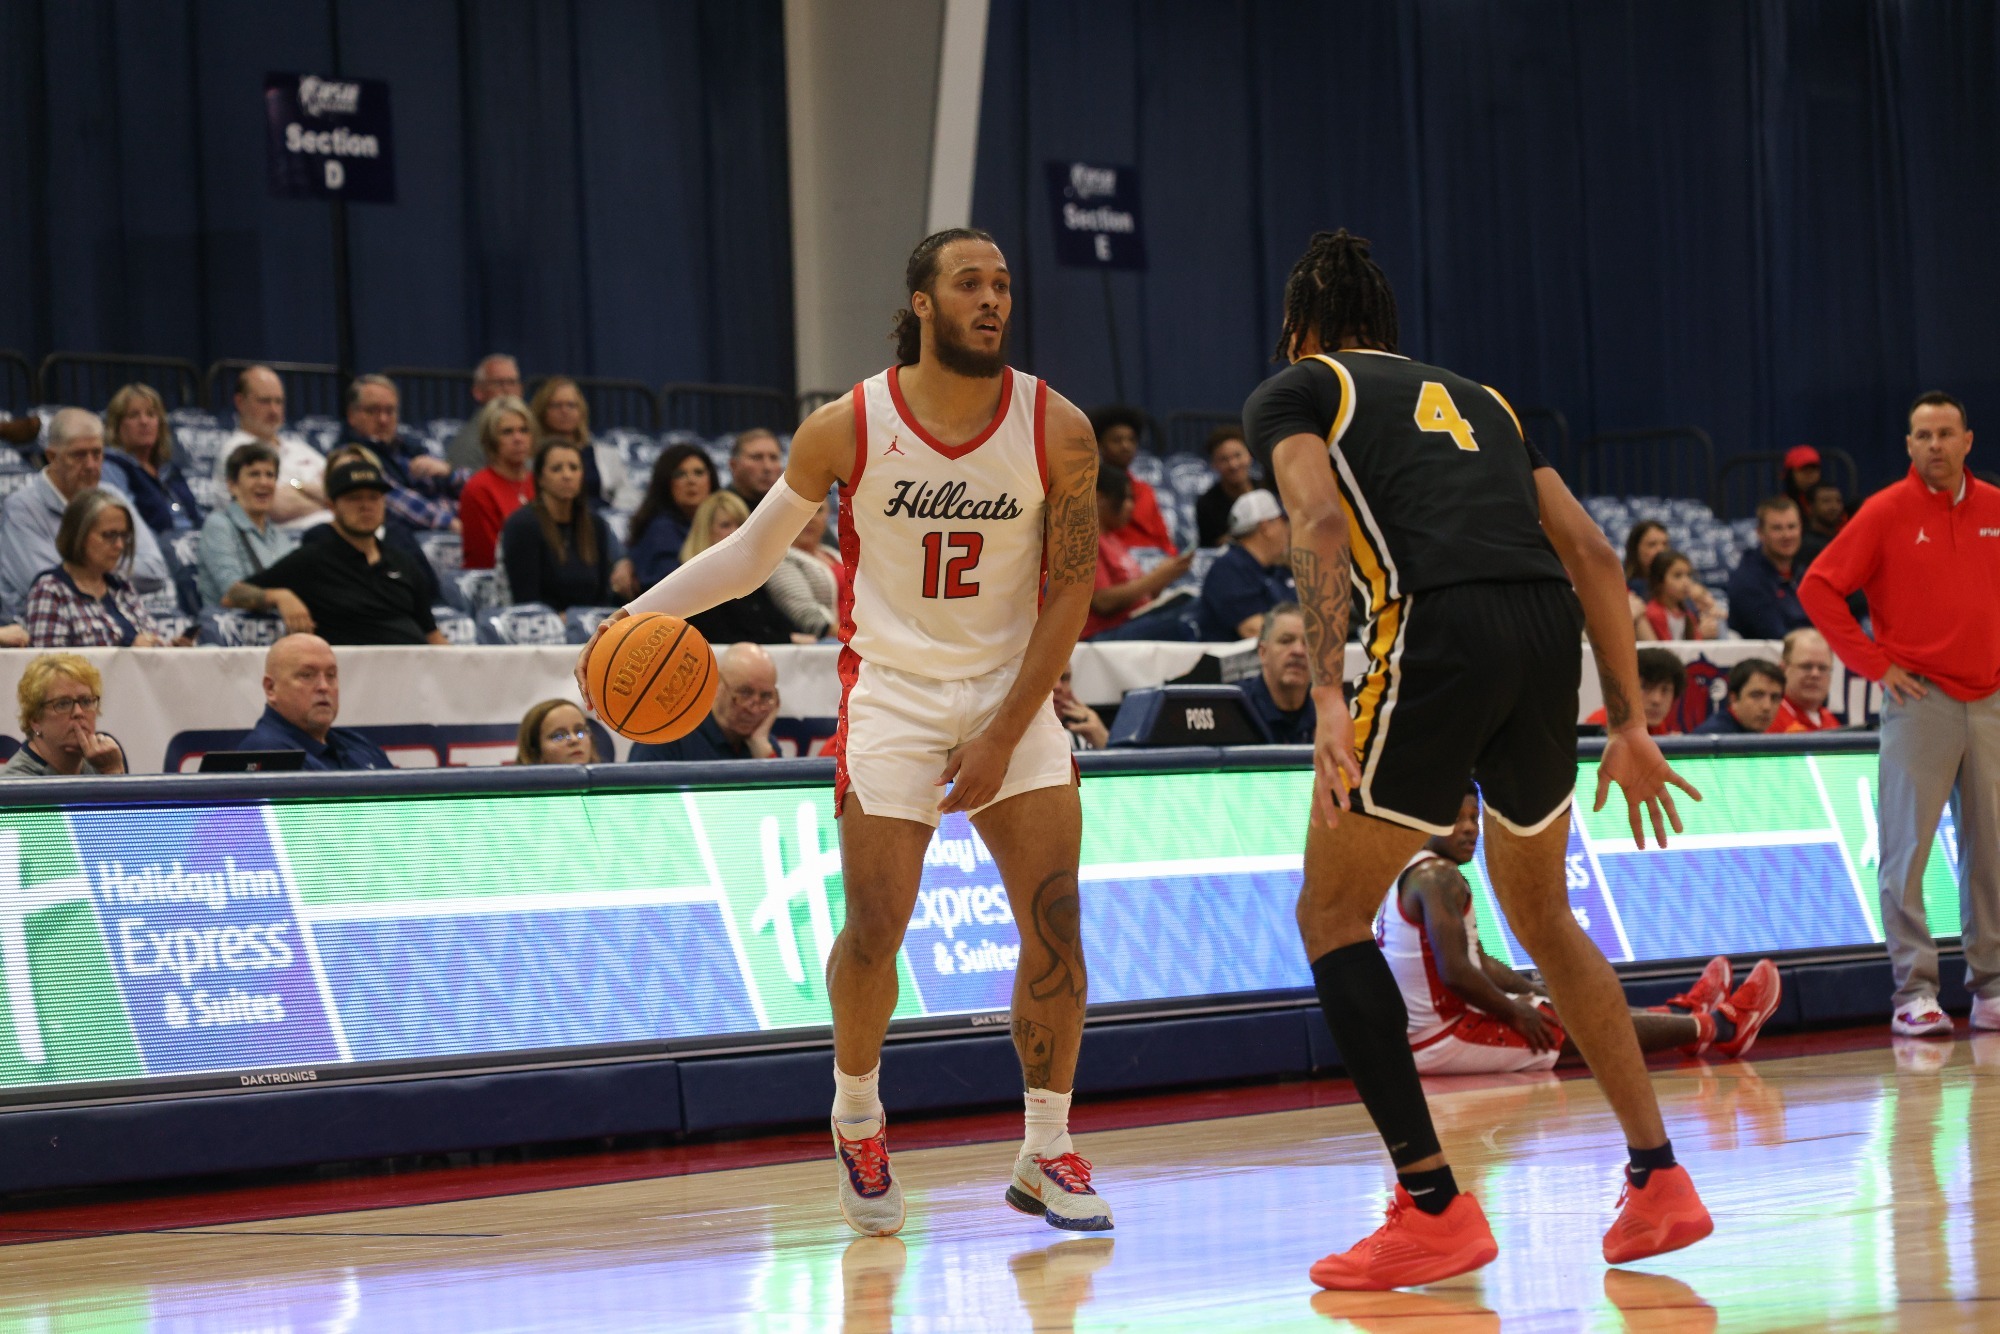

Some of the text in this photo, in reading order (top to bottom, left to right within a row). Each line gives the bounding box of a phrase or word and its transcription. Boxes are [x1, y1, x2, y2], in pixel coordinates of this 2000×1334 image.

[286, 123, 379, 158] Section
[324, 159, 345, 190] D
[1413, 380, 1480, 451] 4
[884, 480, 1023, 520] Hillcats
[921, 532, 984, 599] 12
[612, 624, 675, 697] Wilson
[1186, 708, 1215, 730] POSS
[100, 856, 281, 909] Holiday Inn
[908, 884, 1015, 938] xpres
[118, 918, 295, 986] Express
[933, 938, 1020, 976] & Suite
[163, 987, 287, 1029] & Suites
[240, 1070, 317, 1086] DAKTRONICS
